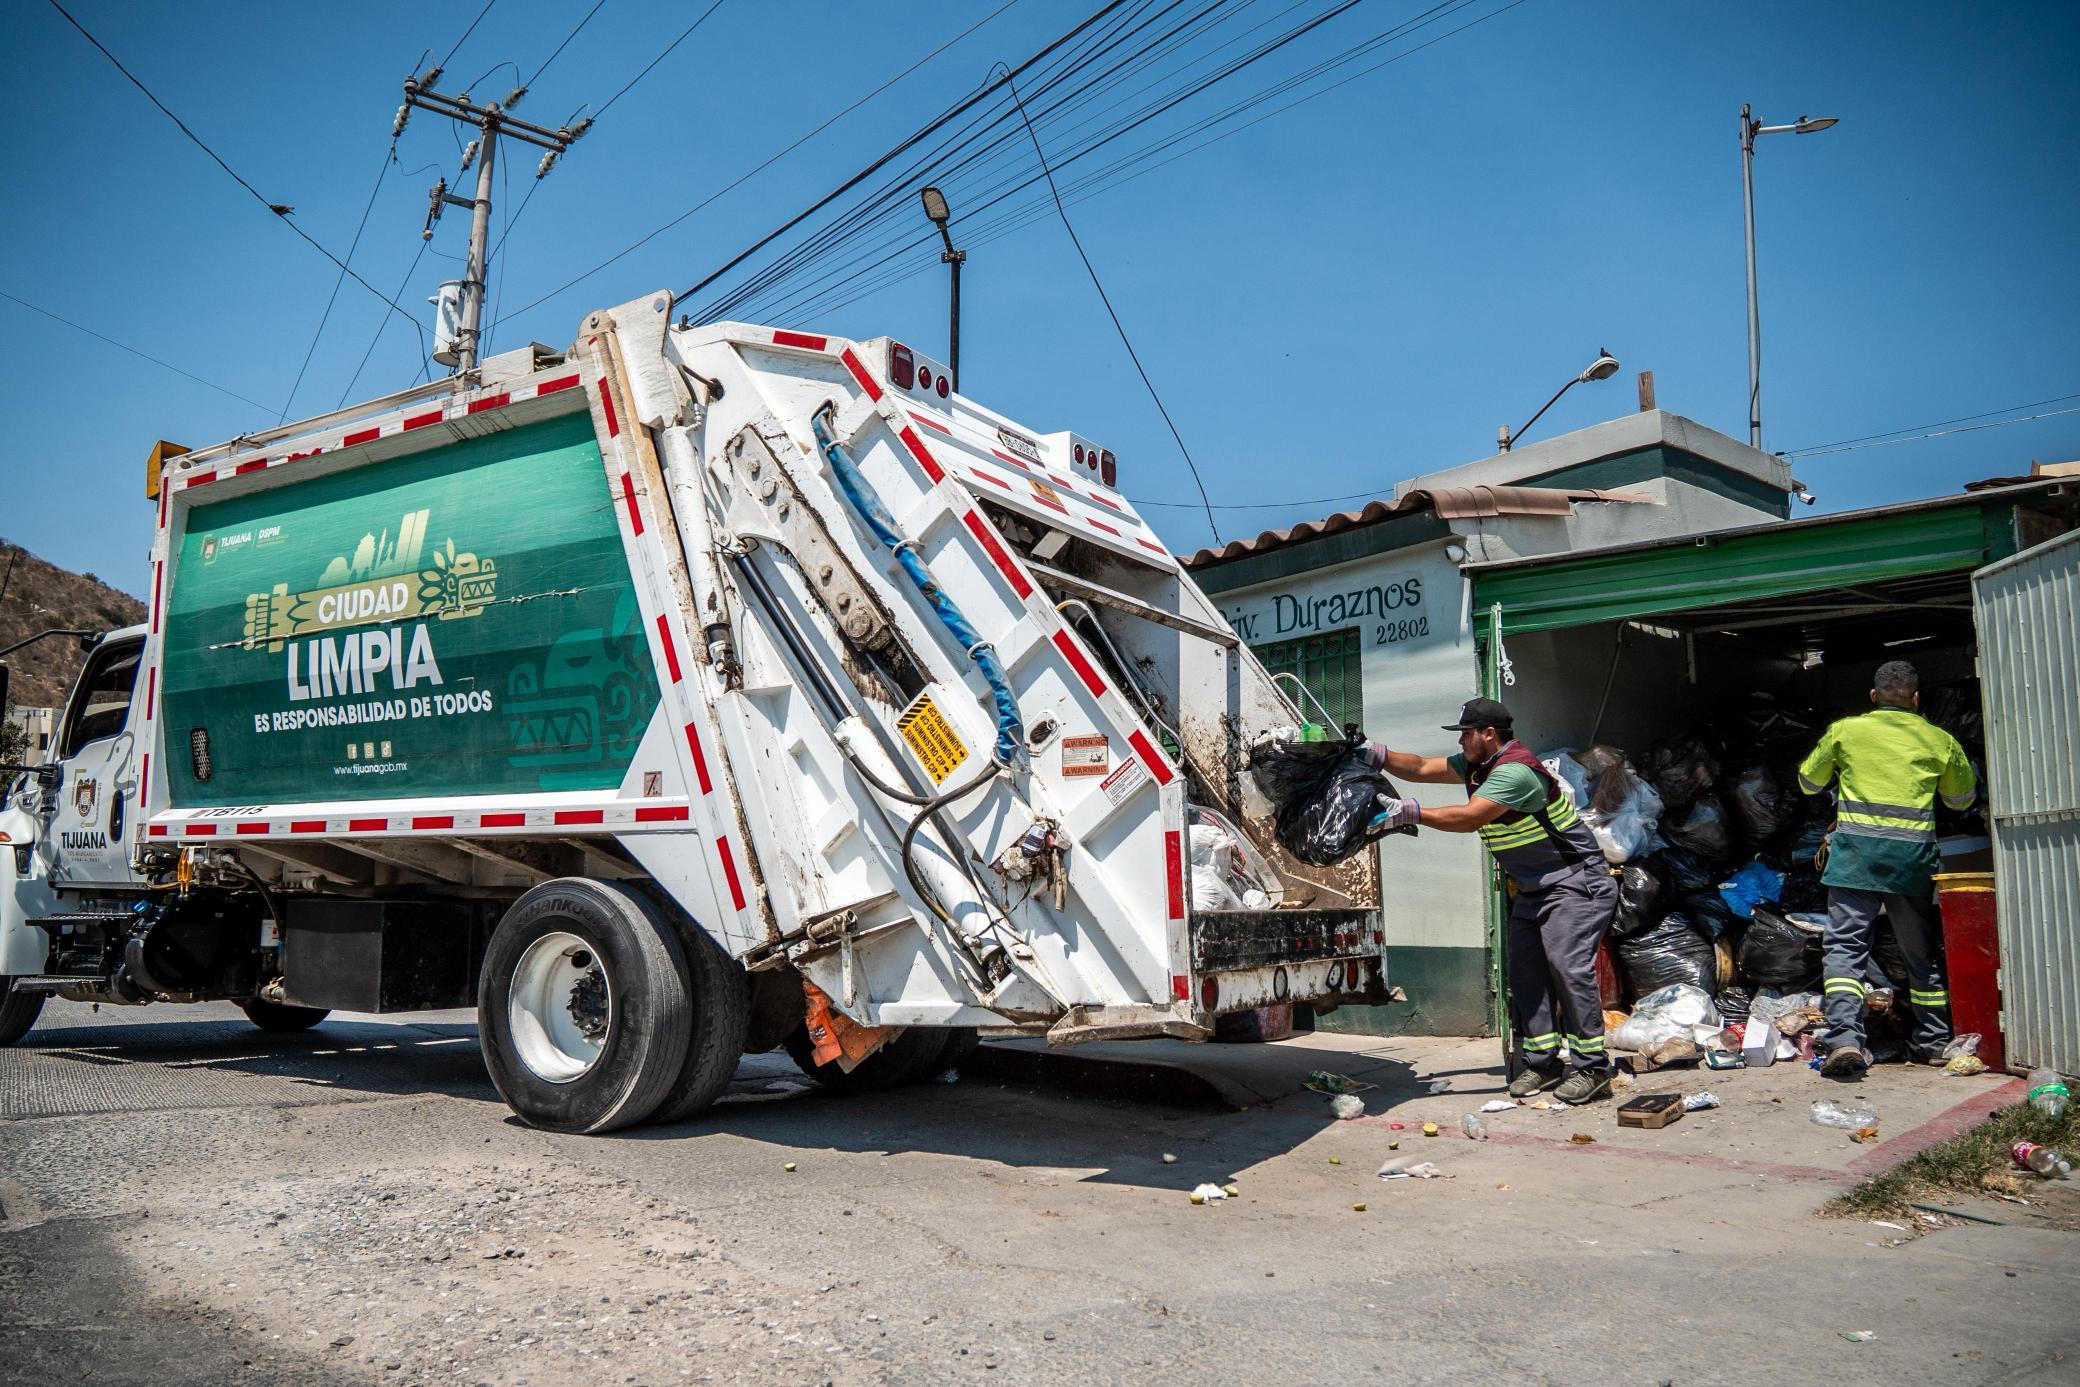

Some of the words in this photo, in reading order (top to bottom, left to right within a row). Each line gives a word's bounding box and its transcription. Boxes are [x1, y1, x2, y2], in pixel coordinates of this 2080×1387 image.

[221, 532, 252, 548] TIJUANA
[258, 525, 281, 540] DSPM
[318, 582, 409, 624] CIUDAD
[1219, 606, 1260, 640] riv.
[1272, 577, 1422, 634] Duraznos
[1376, 616, 1430, 645] 22802
[287, 623, 443, 701] LIMPIA
[254, 713, 270, 733] ES
[273, 699, 407, 732] RESPONSABILIDAD
[410, 696, 432, 718] DE
[434, 690, 493, 716] TODOS
[919, 714, 930, 726] CIP
[927, 706, 938, 718] CIP
[904, 729, 931, 765] SUMINISTRO
[927, 762, 938, 774] CIP
[912, 721, 939, 757] SUMINISTRO
[935, 755, 946, 767] CIP
[926, 723, 954, 760] SUMINISTRO
[934, 715, 962, 752] SUMINISTRO
[1071, 766, 1107, 775] WARNING
[61, 831, 107, 849] TIJUANA
